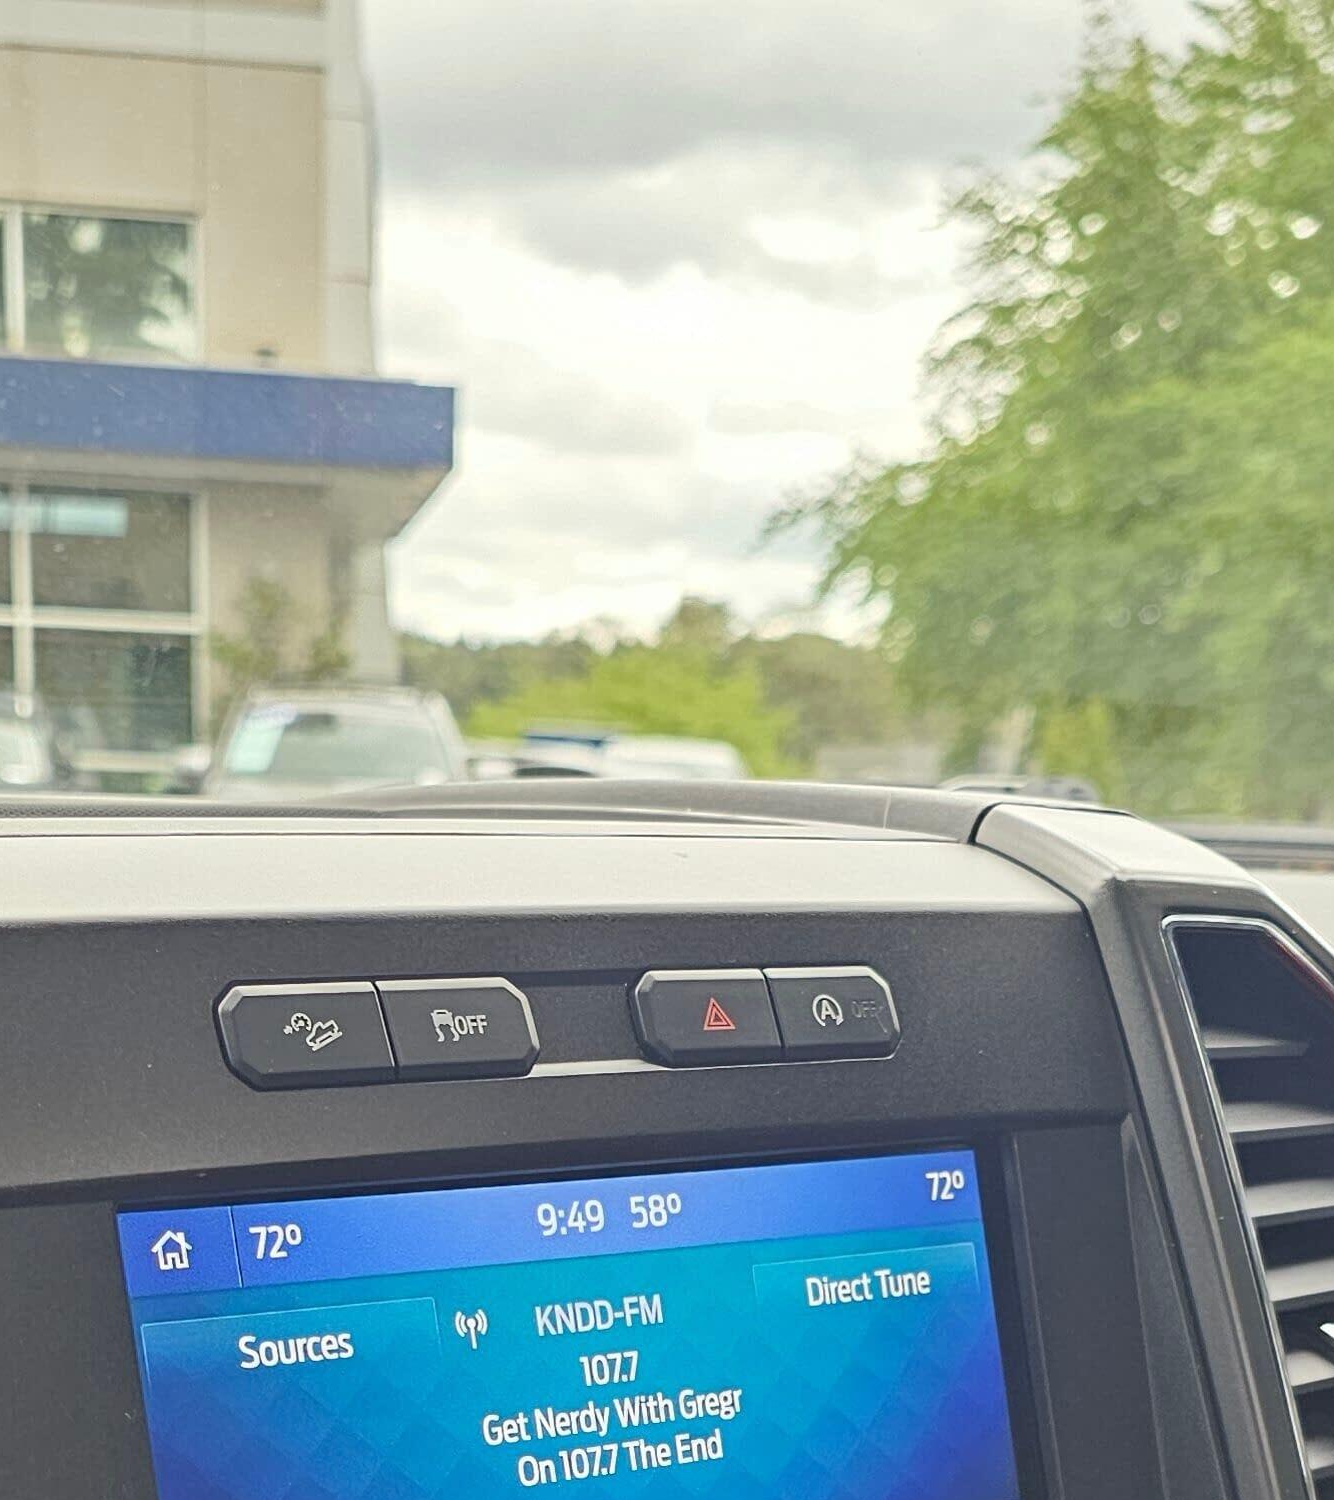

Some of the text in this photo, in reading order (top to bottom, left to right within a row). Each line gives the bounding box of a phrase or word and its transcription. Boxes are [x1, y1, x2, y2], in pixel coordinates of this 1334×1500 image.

[454, 1014, 488, 1035] OFF
[537, 1199, 605, 1237] 9:49
[806, 1269, 932, 1308] Direct Tune
[535, 1293, 664, 1336] KNDD-FM
[237, 1332, 354, 1370] Sources
[579, 1350, 639, 1387] 107.7
[482, 1387, 743, 1446] Get Nerdy With Gregr
[518, 1429, 724, 1487] On 107.7 The End
